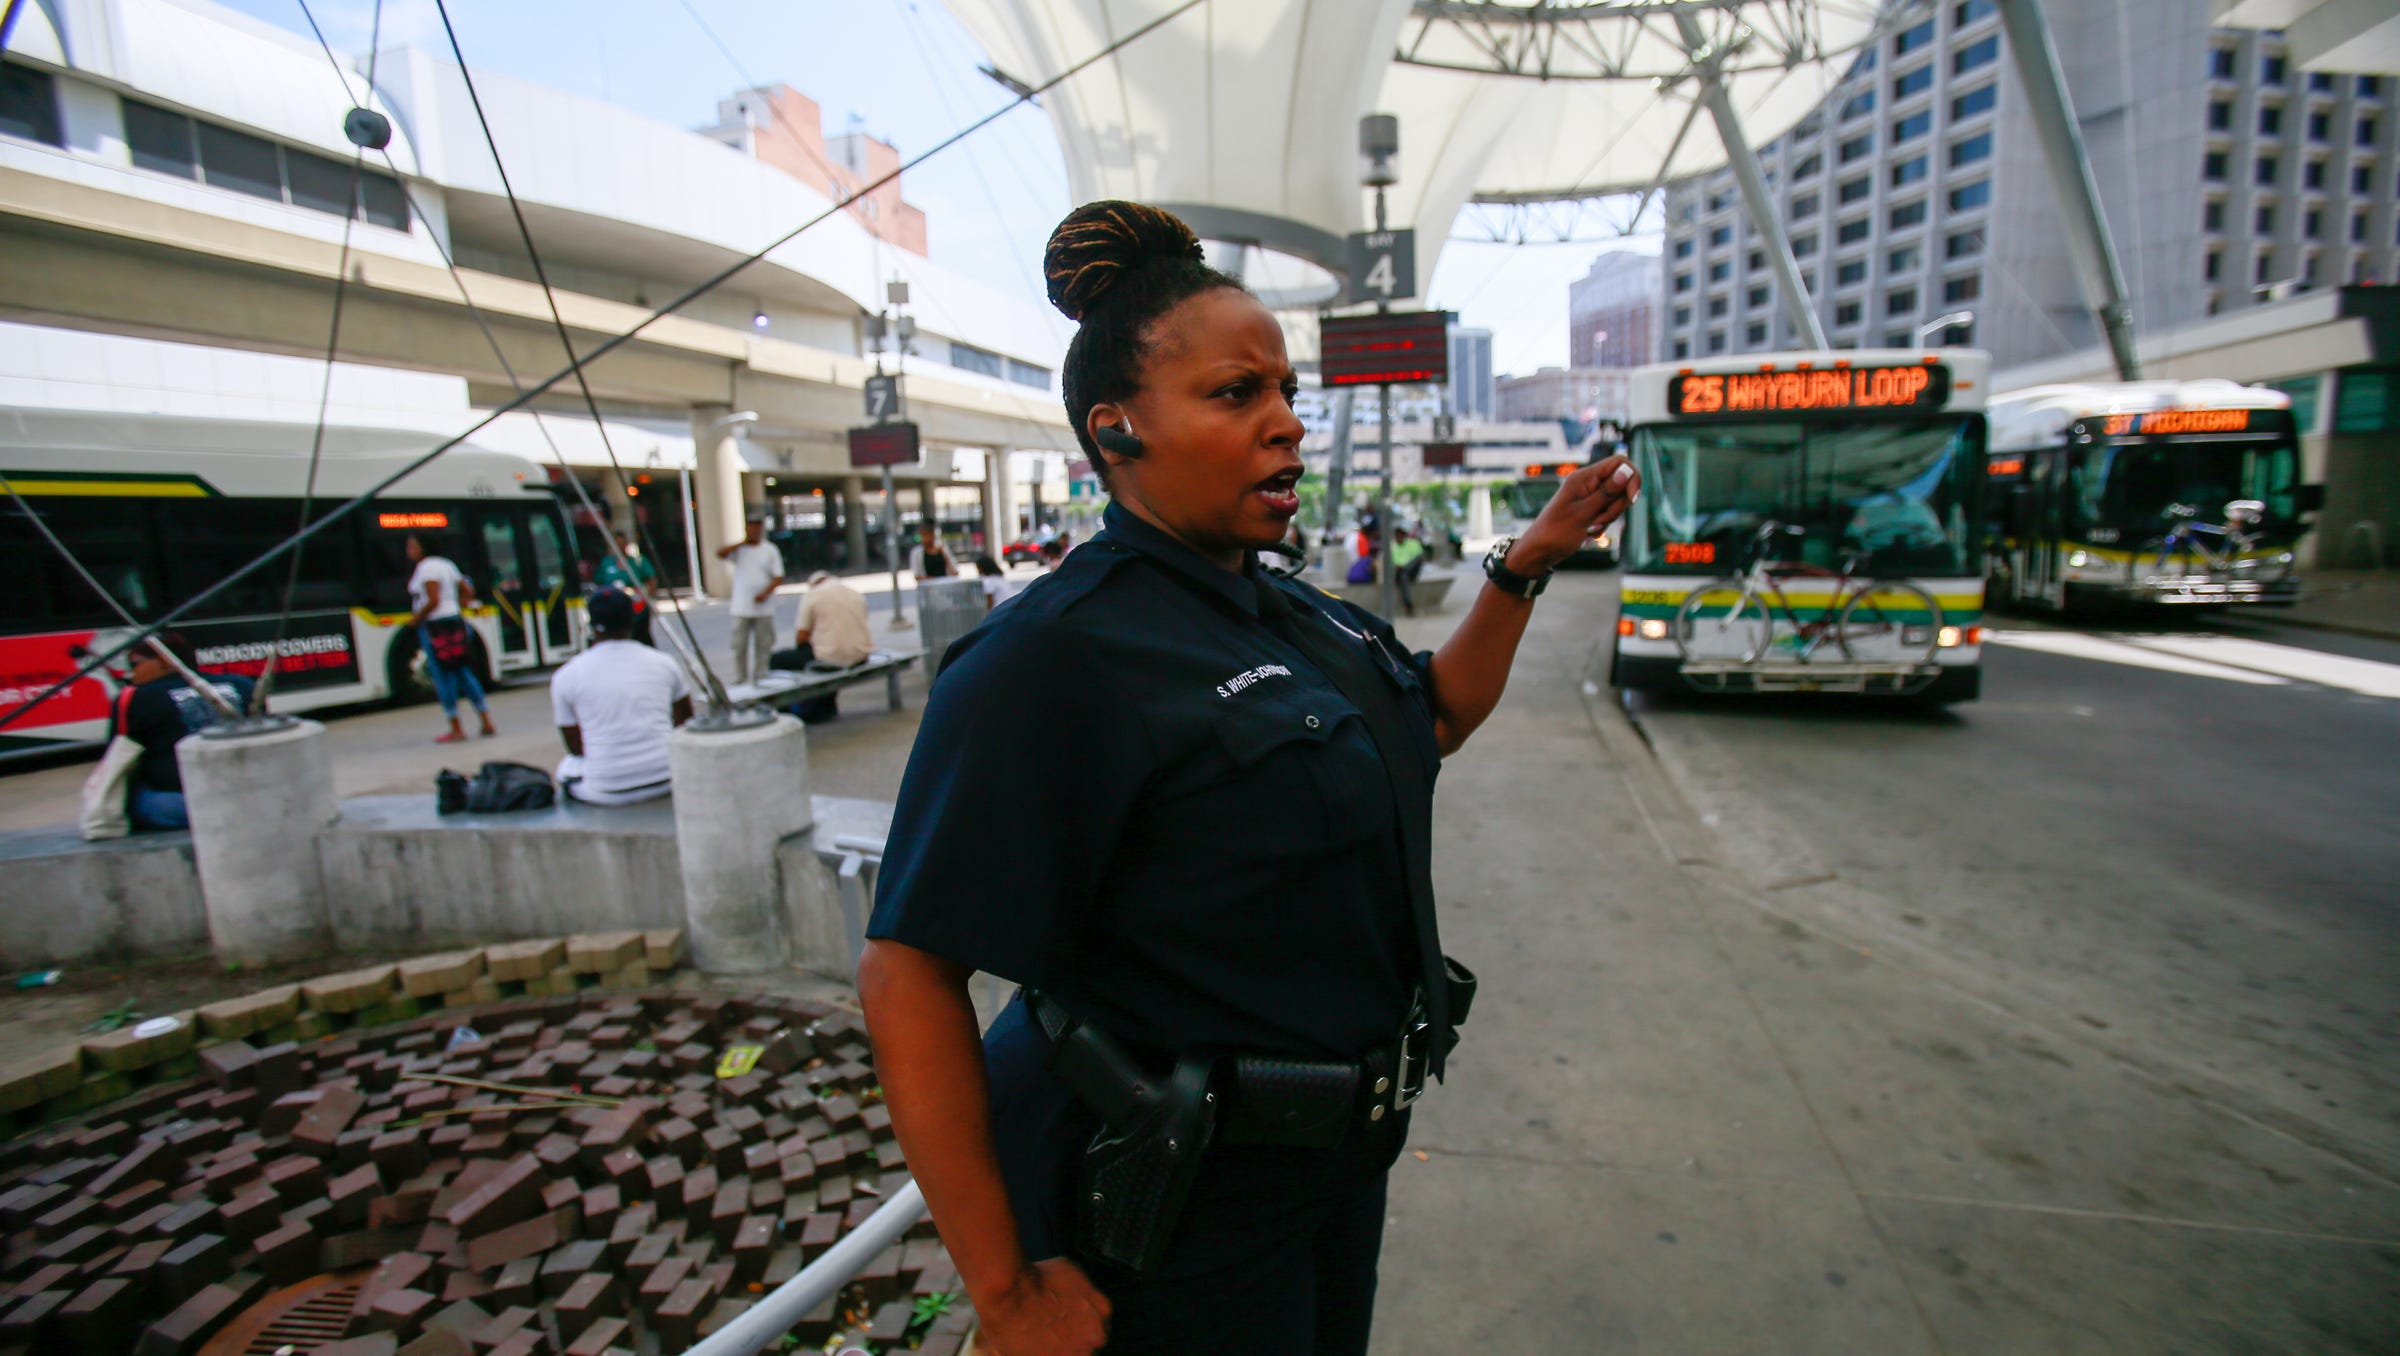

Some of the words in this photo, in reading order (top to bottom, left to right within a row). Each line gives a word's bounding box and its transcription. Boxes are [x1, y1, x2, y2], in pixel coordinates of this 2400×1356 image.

[1365, 254, 1397, 296] 4
[1681, 376, 1724, 413] 25
[1727, 370, 1851, 411] WAYBURN
[1855, 366, 1929, 406] LOOP
[872, 390, 887, 415] 7
[2139, 409, 2249, 434] MICHIGAN
[1216, 686, 1231, 698] S.
